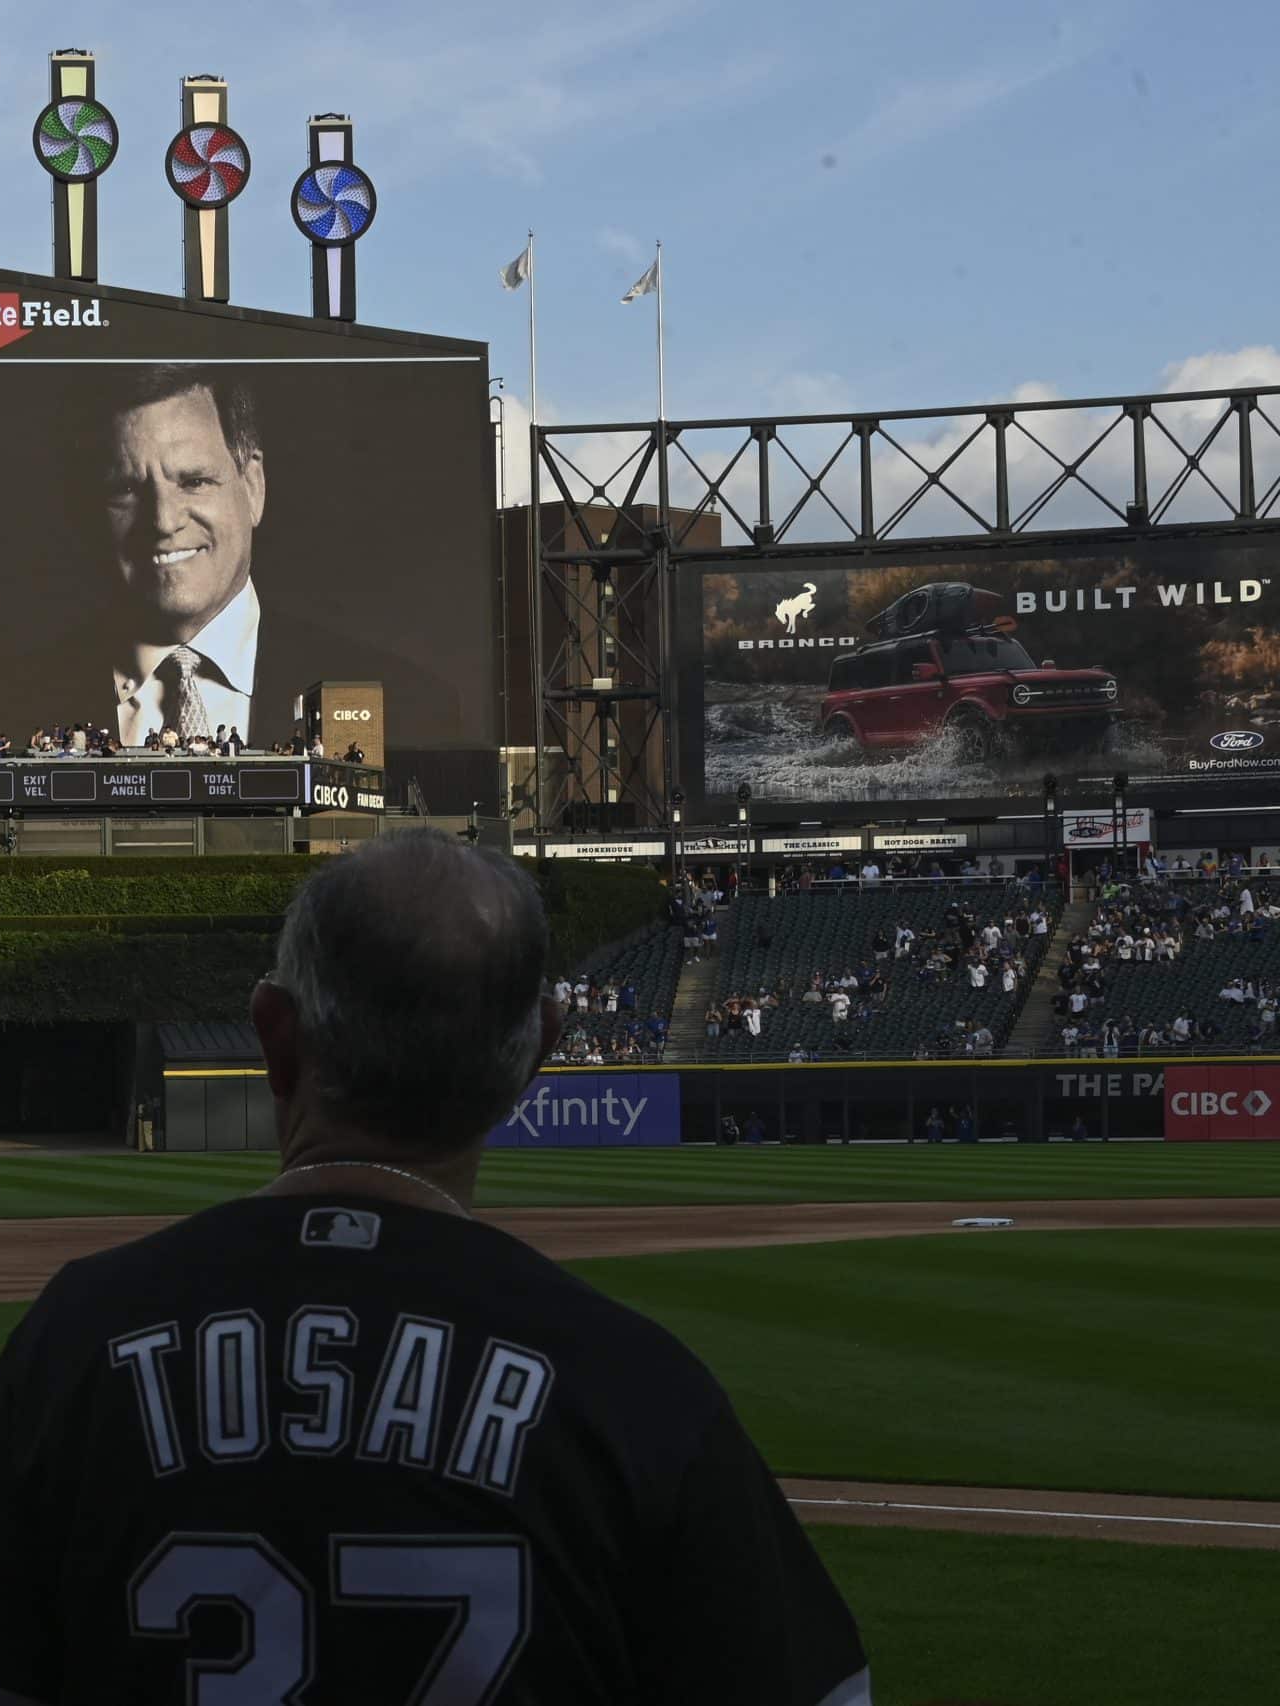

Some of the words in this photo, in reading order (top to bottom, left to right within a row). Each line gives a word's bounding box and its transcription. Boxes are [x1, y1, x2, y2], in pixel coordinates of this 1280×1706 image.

[1016, 586, 1137, 614] BUILT
[333, 710, 359, 721] CIBC
[1220, 733, 1254, 748] Ford
[23, 775, 47, 786] EXIT
[103, 775, 147, 785] LAUNCH
[203, 773, 236, 784] TOTAL
[111, 785, 147, 796] ANGLE
[208, 785, 237, 795] DIST.
[314, 784, 338, 807] CIBC
[357, 792, 369, 807] FAN
[369, 794, 385, 809] DECK
[1055, 1073, 1122, 1097] THE
[506, 1086, 648, 1137] xfinity
[1171, 1091, 1239, 1116] CIBC
[107, 1304, 556, 1498] TOSAR
[127, 1530, 533, 1706] 37
